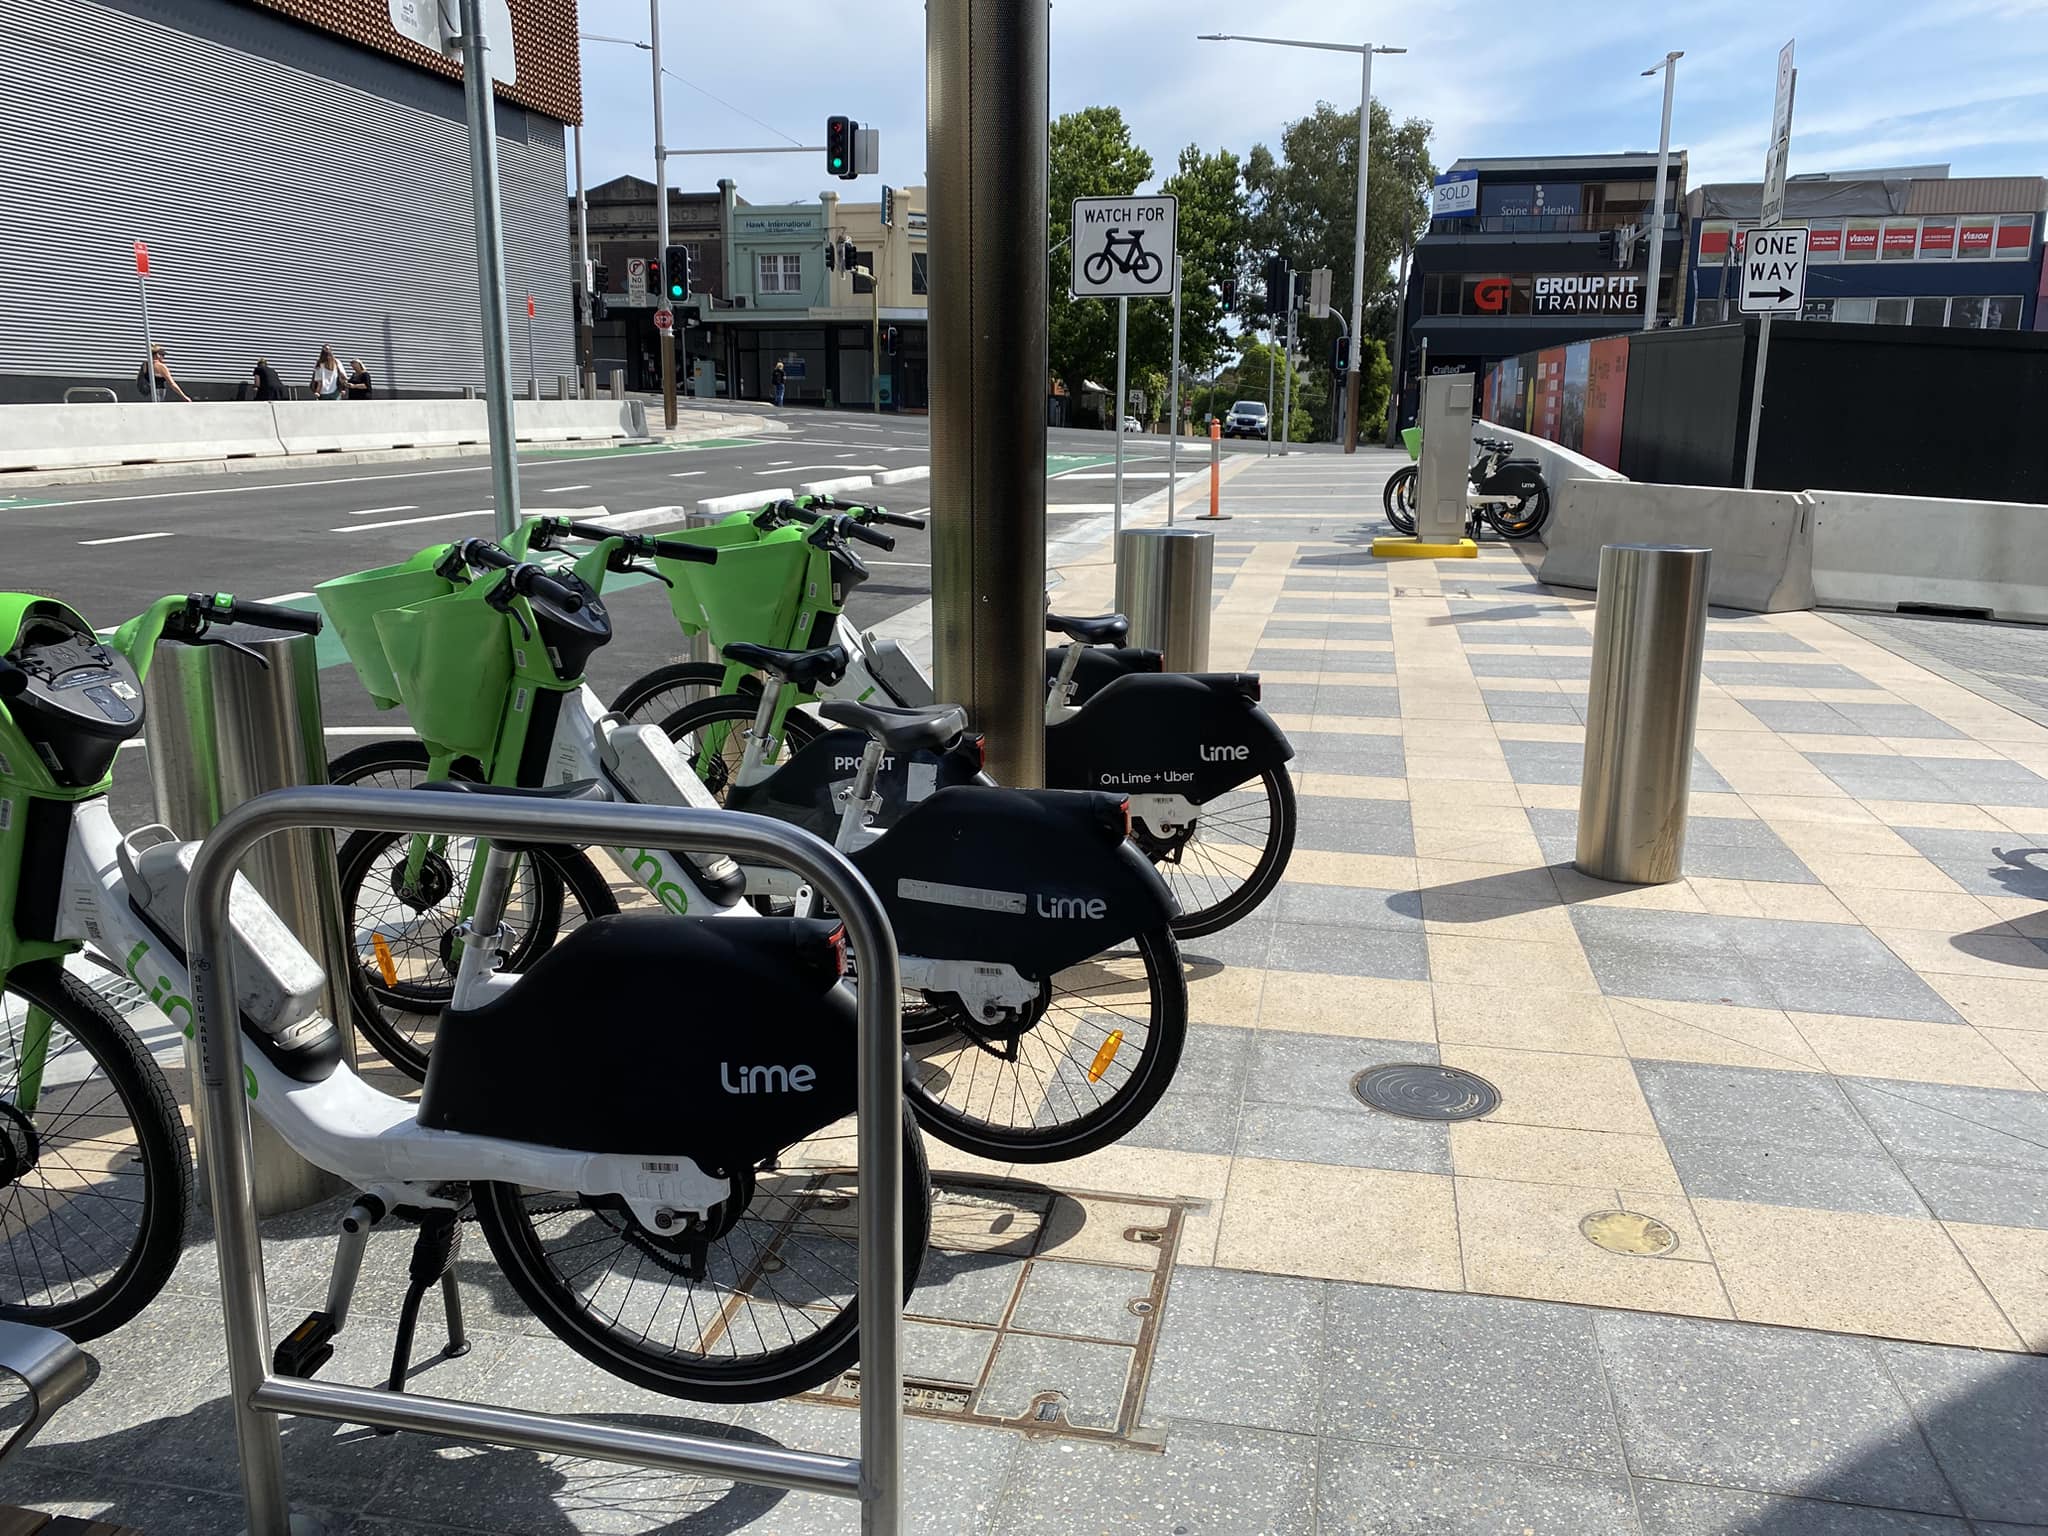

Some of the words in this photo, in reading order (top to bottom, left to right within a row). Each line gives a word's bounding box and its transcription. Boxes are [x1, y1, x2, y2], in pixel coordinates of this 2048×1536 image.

[1439, 184, 1470, 201] SOLD
[1084, 208, 1132, 223] WATCH
[1137, 207, 1165, 222] FOR
[1501, 206, 1528, 216] Spine
[1542, 205, 1575, 216] Health
[745, 220, 765, 228] Hawk
[767, 219, 812, 228] International
[1755, 236, 1798, 255] ONE
[1750, 262, 1799, 281] WAY
[1535, 276, 1605, 295] GROUP
[1607, 276, 1639, 294] FIT
[1535, 294, 1639, 311] TRAINING
[1200, 744, 1250, 762] Lime
[1100, 773, 1120, 785] On
[1121, 772, 1152, 784] Lime
[1163, 771, 1195, 783] Uber
[1036, 893, 1108, 920] Lime
[194, 974, 210, 1073] SECURABIKE
[720, 1062, 817, 1094] Lime
